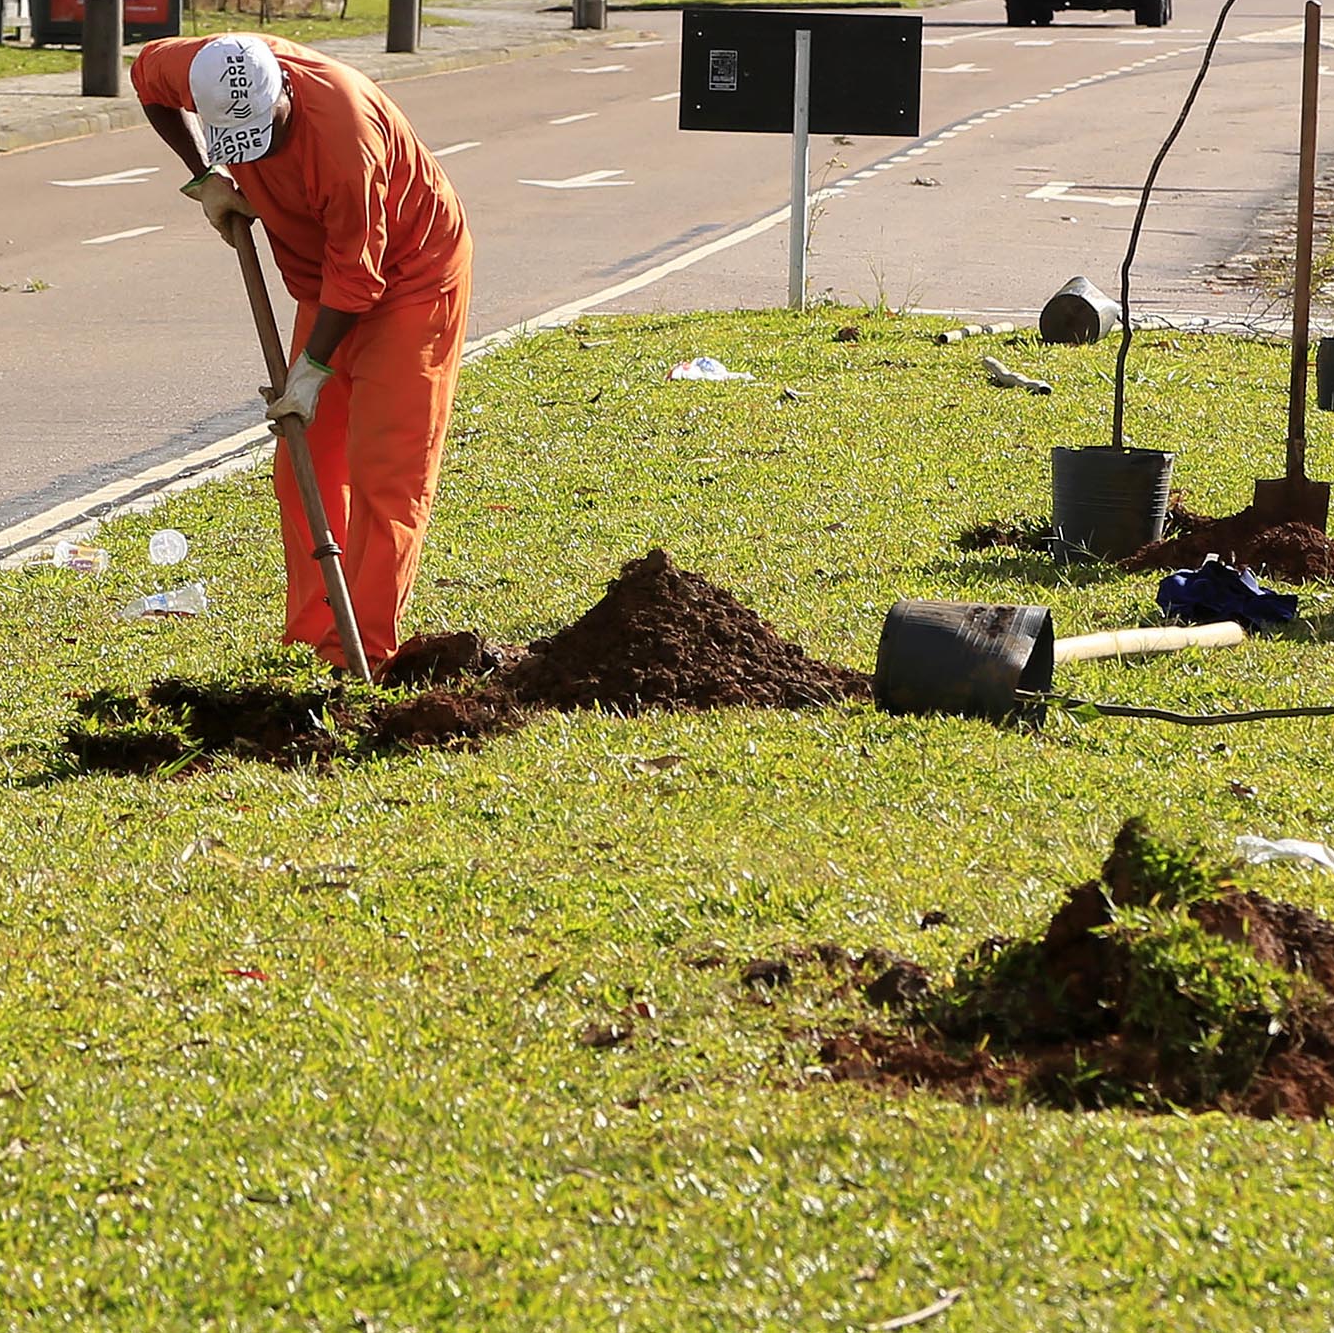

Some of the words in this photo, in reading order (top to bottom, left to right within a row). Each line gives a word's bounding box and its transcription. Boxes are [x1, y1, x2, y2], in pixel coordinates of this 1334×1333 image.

[227, 55, 240, 99] DROP
[235, 55, 248, 99] ZONE
[213, 127, 261, 152] DROP
